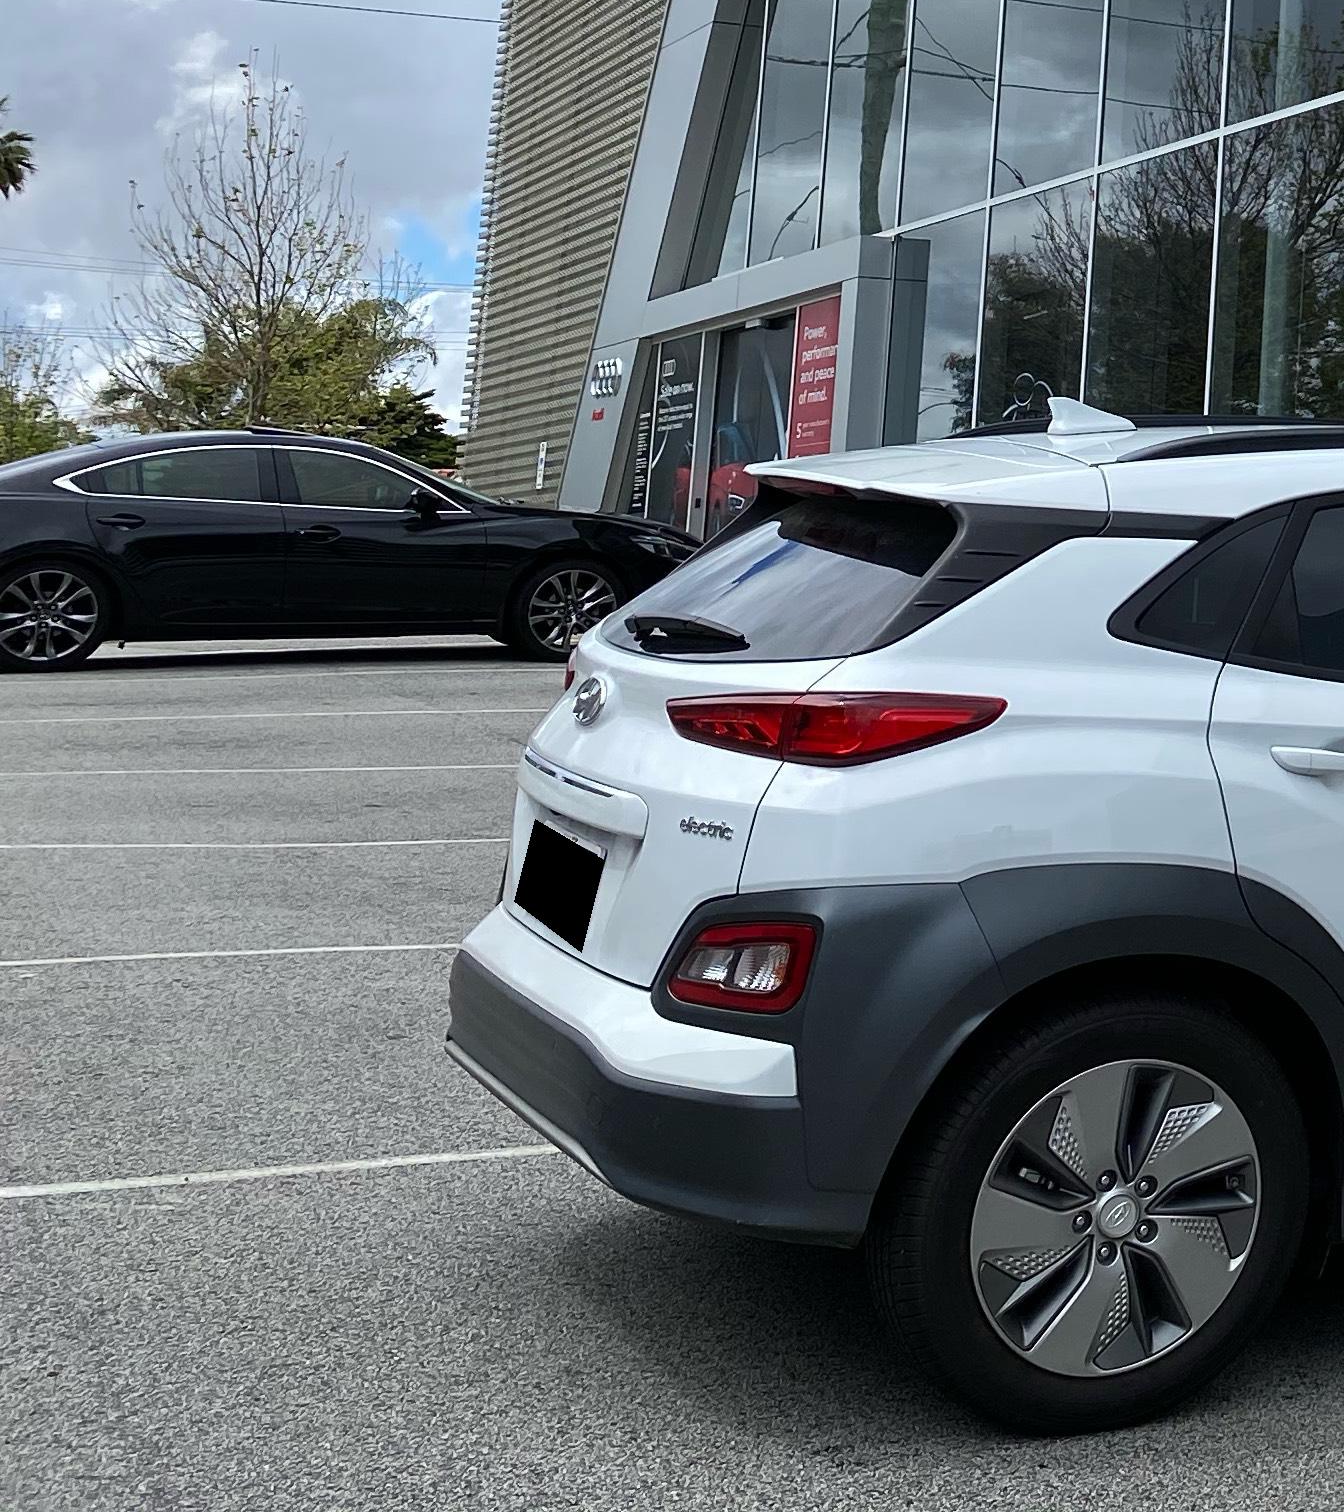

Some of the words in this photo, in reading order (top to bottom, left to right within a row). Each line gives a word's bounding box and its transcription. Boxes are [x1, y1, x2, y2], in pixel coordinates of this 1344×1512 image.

[800, 367, 814, 384] and
[814, 367, 835, 384] peace
[799, 389, 807, 405] of
[807, 386, 828, 403] mind.
[796, 422, 802, 439] 5
[680, 816, 734, 841] electric
